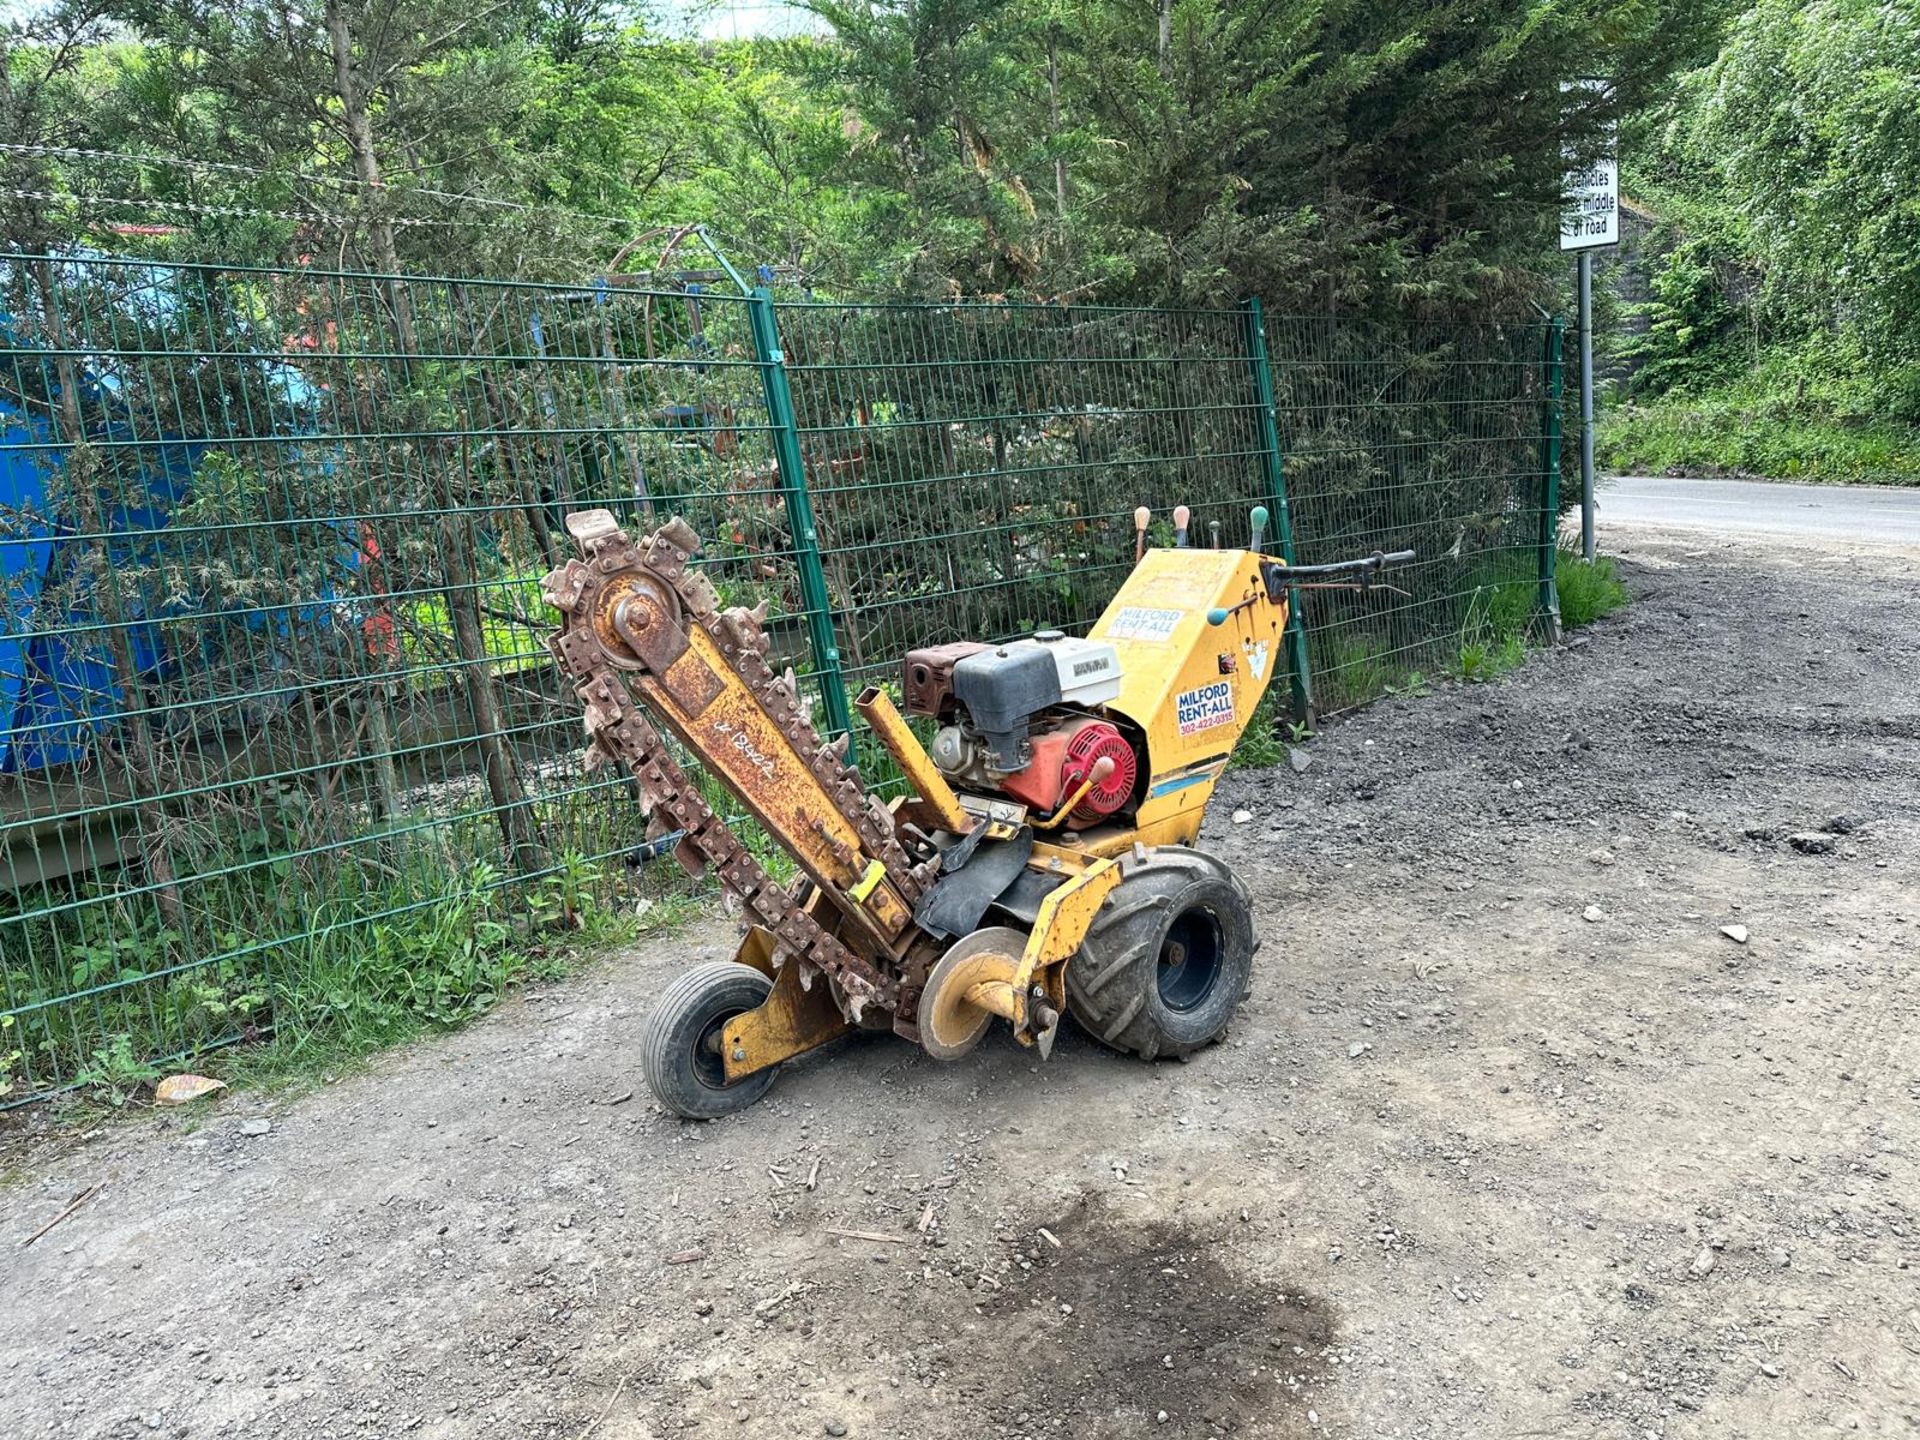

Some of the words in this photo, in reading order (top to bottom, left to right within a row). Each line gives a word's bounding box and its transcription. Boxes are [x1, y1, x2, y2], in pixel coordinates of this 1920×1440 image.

[1570, 170, 1609, 189] ehicles
[1584, 192, 1615, 212] middle
[1586, 216, 1607, 235] road
[1119, 608, 1181, 621] MILFORD
[1113, 618, 1174, 633] RENT-ALL
[1179, 683, 1229, 708] MILFORD
[1178, 697, 1232, 724] RENT-ALL
[1181, 712, 1233, 735] 302-422-0315
